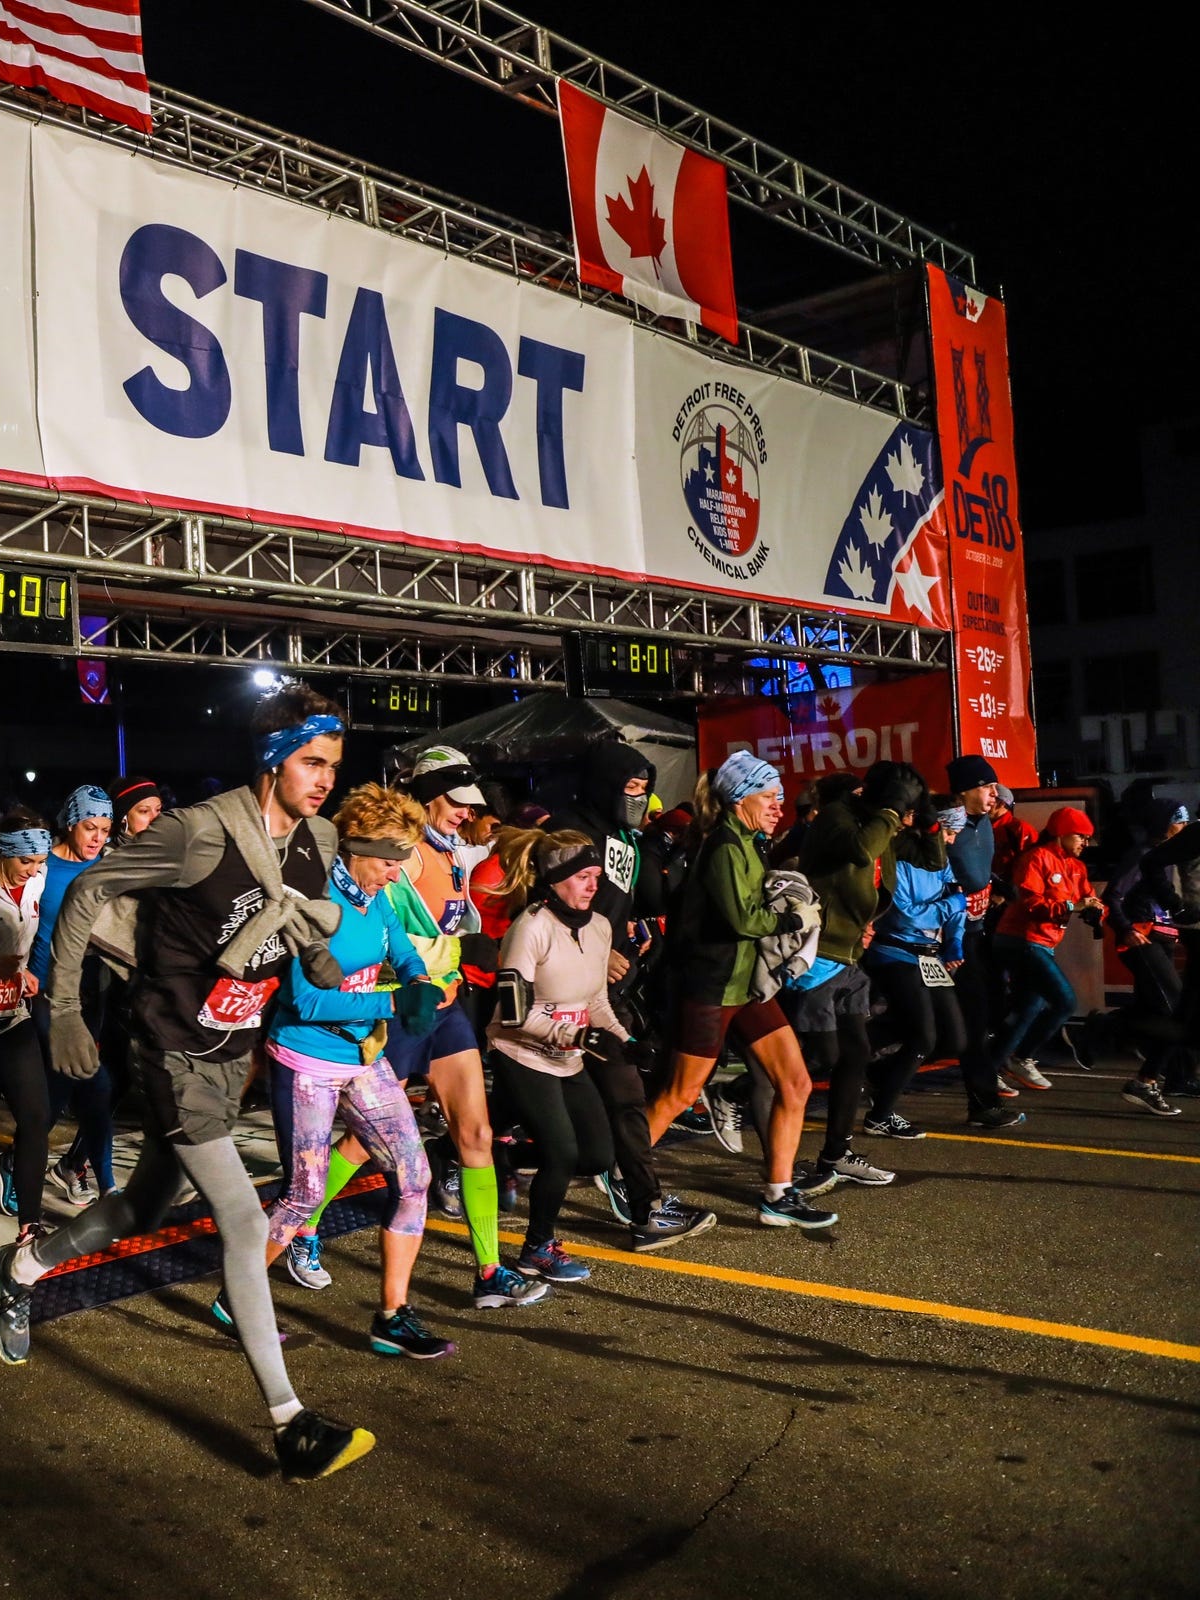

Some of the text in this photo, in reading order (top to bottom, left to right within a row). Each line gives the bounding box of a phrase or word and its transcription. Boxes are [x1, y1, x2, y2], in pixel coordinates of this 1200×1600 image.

[119, 223, 585, 509] START
[672, 382, 768, 465] DETROIT FREE PRESS
[706, 487, 737, 505] MARATHON
[699, 498, 746, 518] HALF-MARATHON
[710, 512, 728, 526] RELAY
[713, 525, 741, 541] KIDS RUN
[687, 525, 770, 580] CHEMICAL BANK
[980, 737, 1008, 759] RELAY
